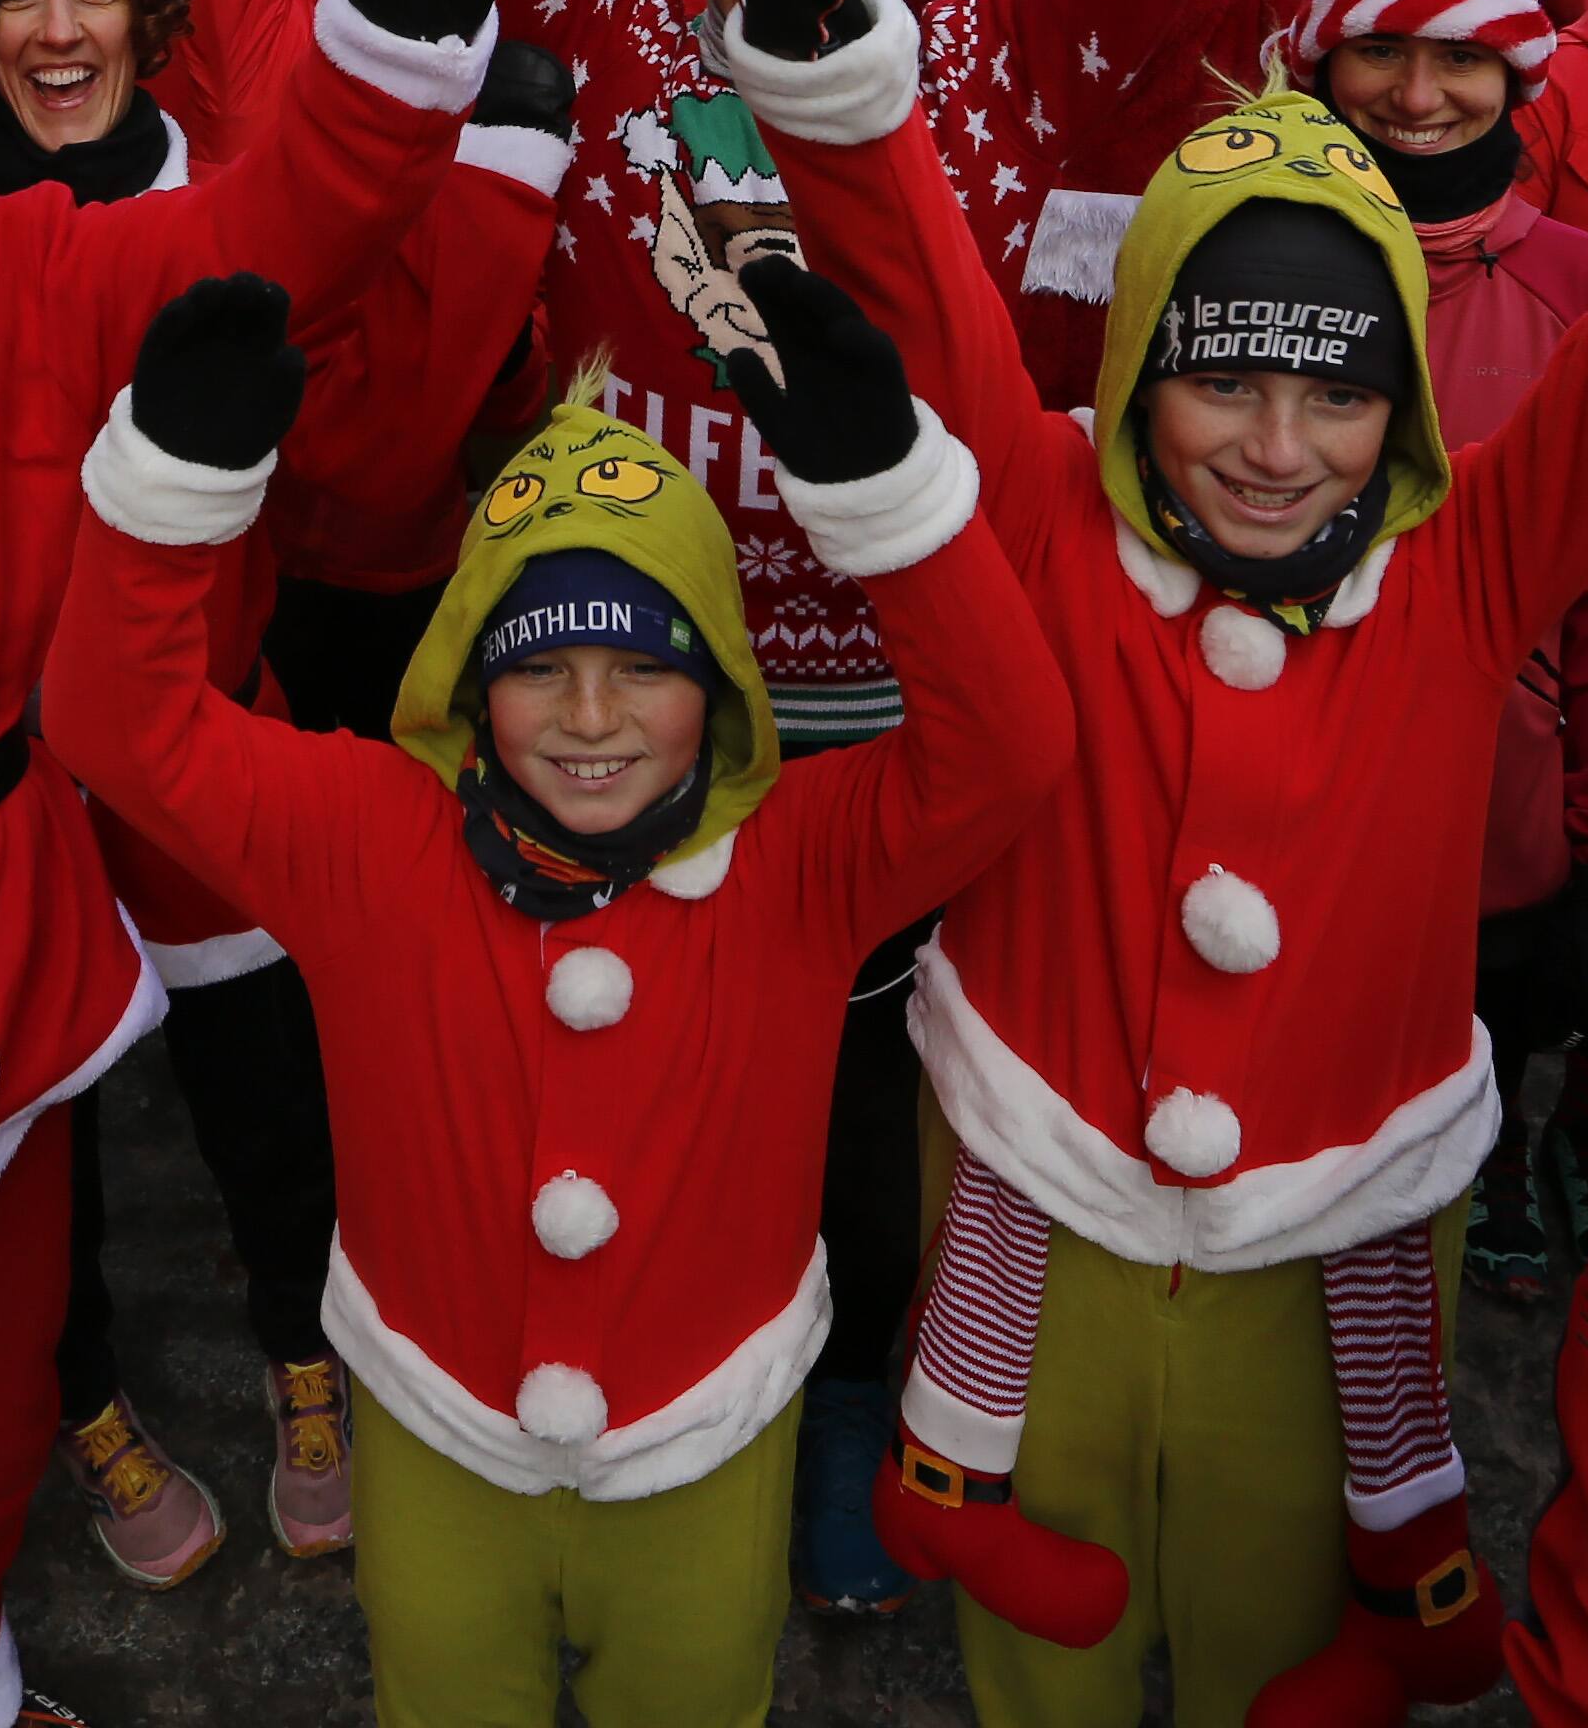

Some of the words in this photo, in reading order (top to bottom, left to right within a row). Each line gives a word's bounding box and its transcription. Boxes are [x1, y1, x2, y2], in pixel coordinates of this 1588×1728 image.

[1194, 295, 1222, 329] le
[1228, 301, 1379, 338] coureur
[1191, 327, 1349, 369] nordique
